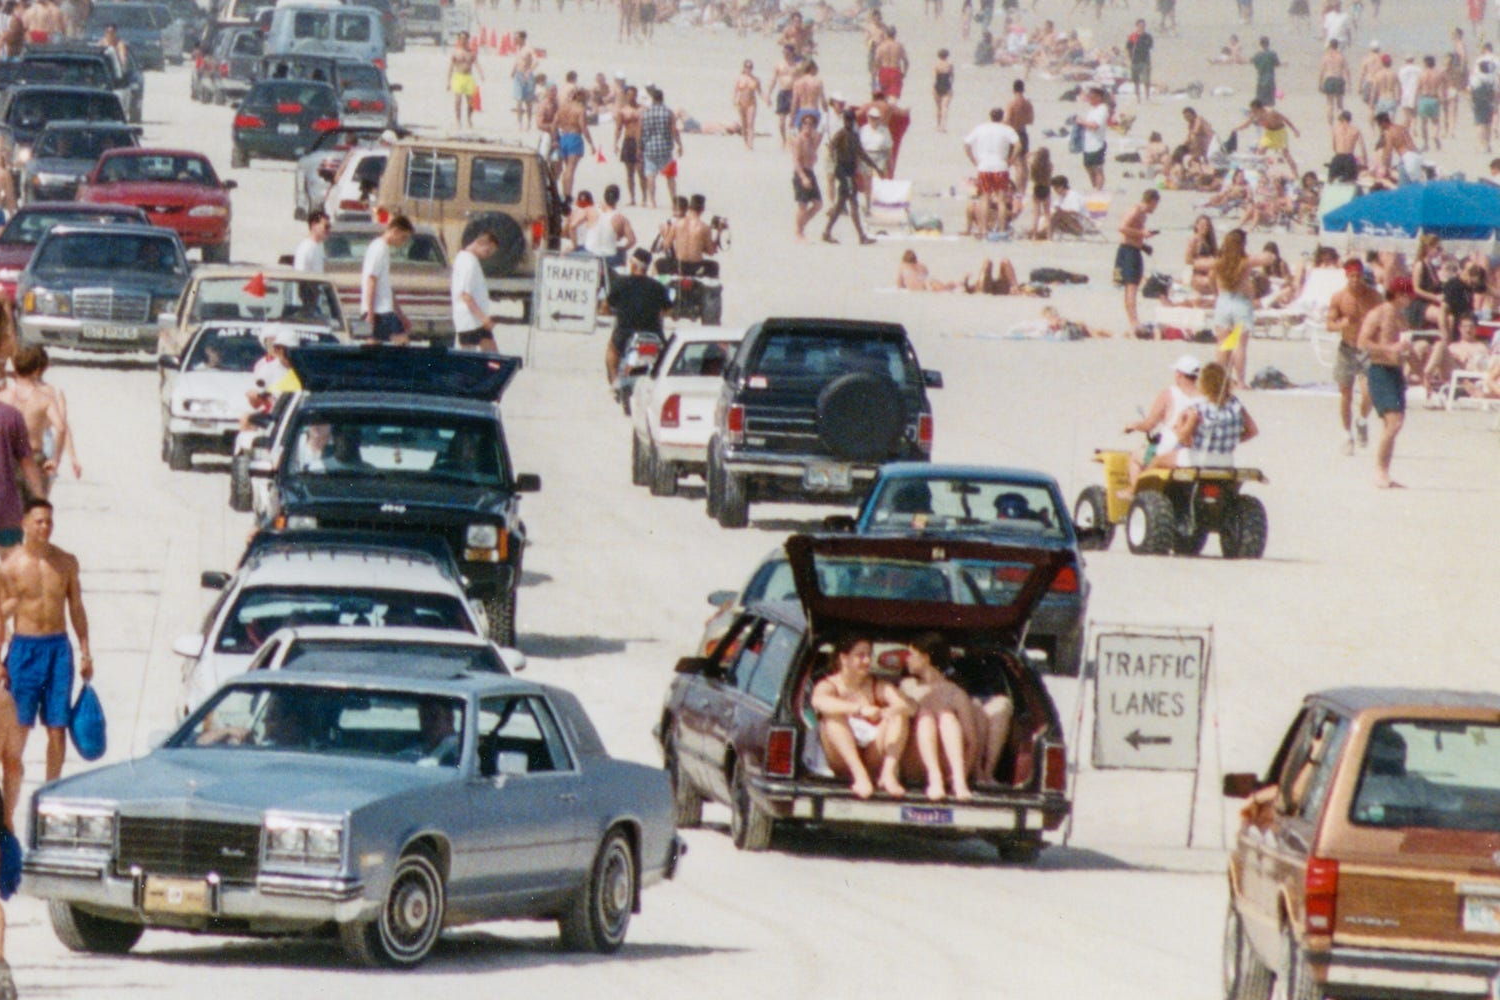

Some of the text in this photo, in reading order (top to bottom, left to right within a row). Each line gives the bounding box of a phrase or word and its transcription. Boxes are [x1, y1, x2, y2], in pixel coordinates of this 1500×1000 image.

[547, 266, 595, 283] TRAFFIC
[547, 288, 589, 305] LANES
[1105, 651, 1197, 679] TRAFFIC
[1110, 691, 1185, 718] LANES
